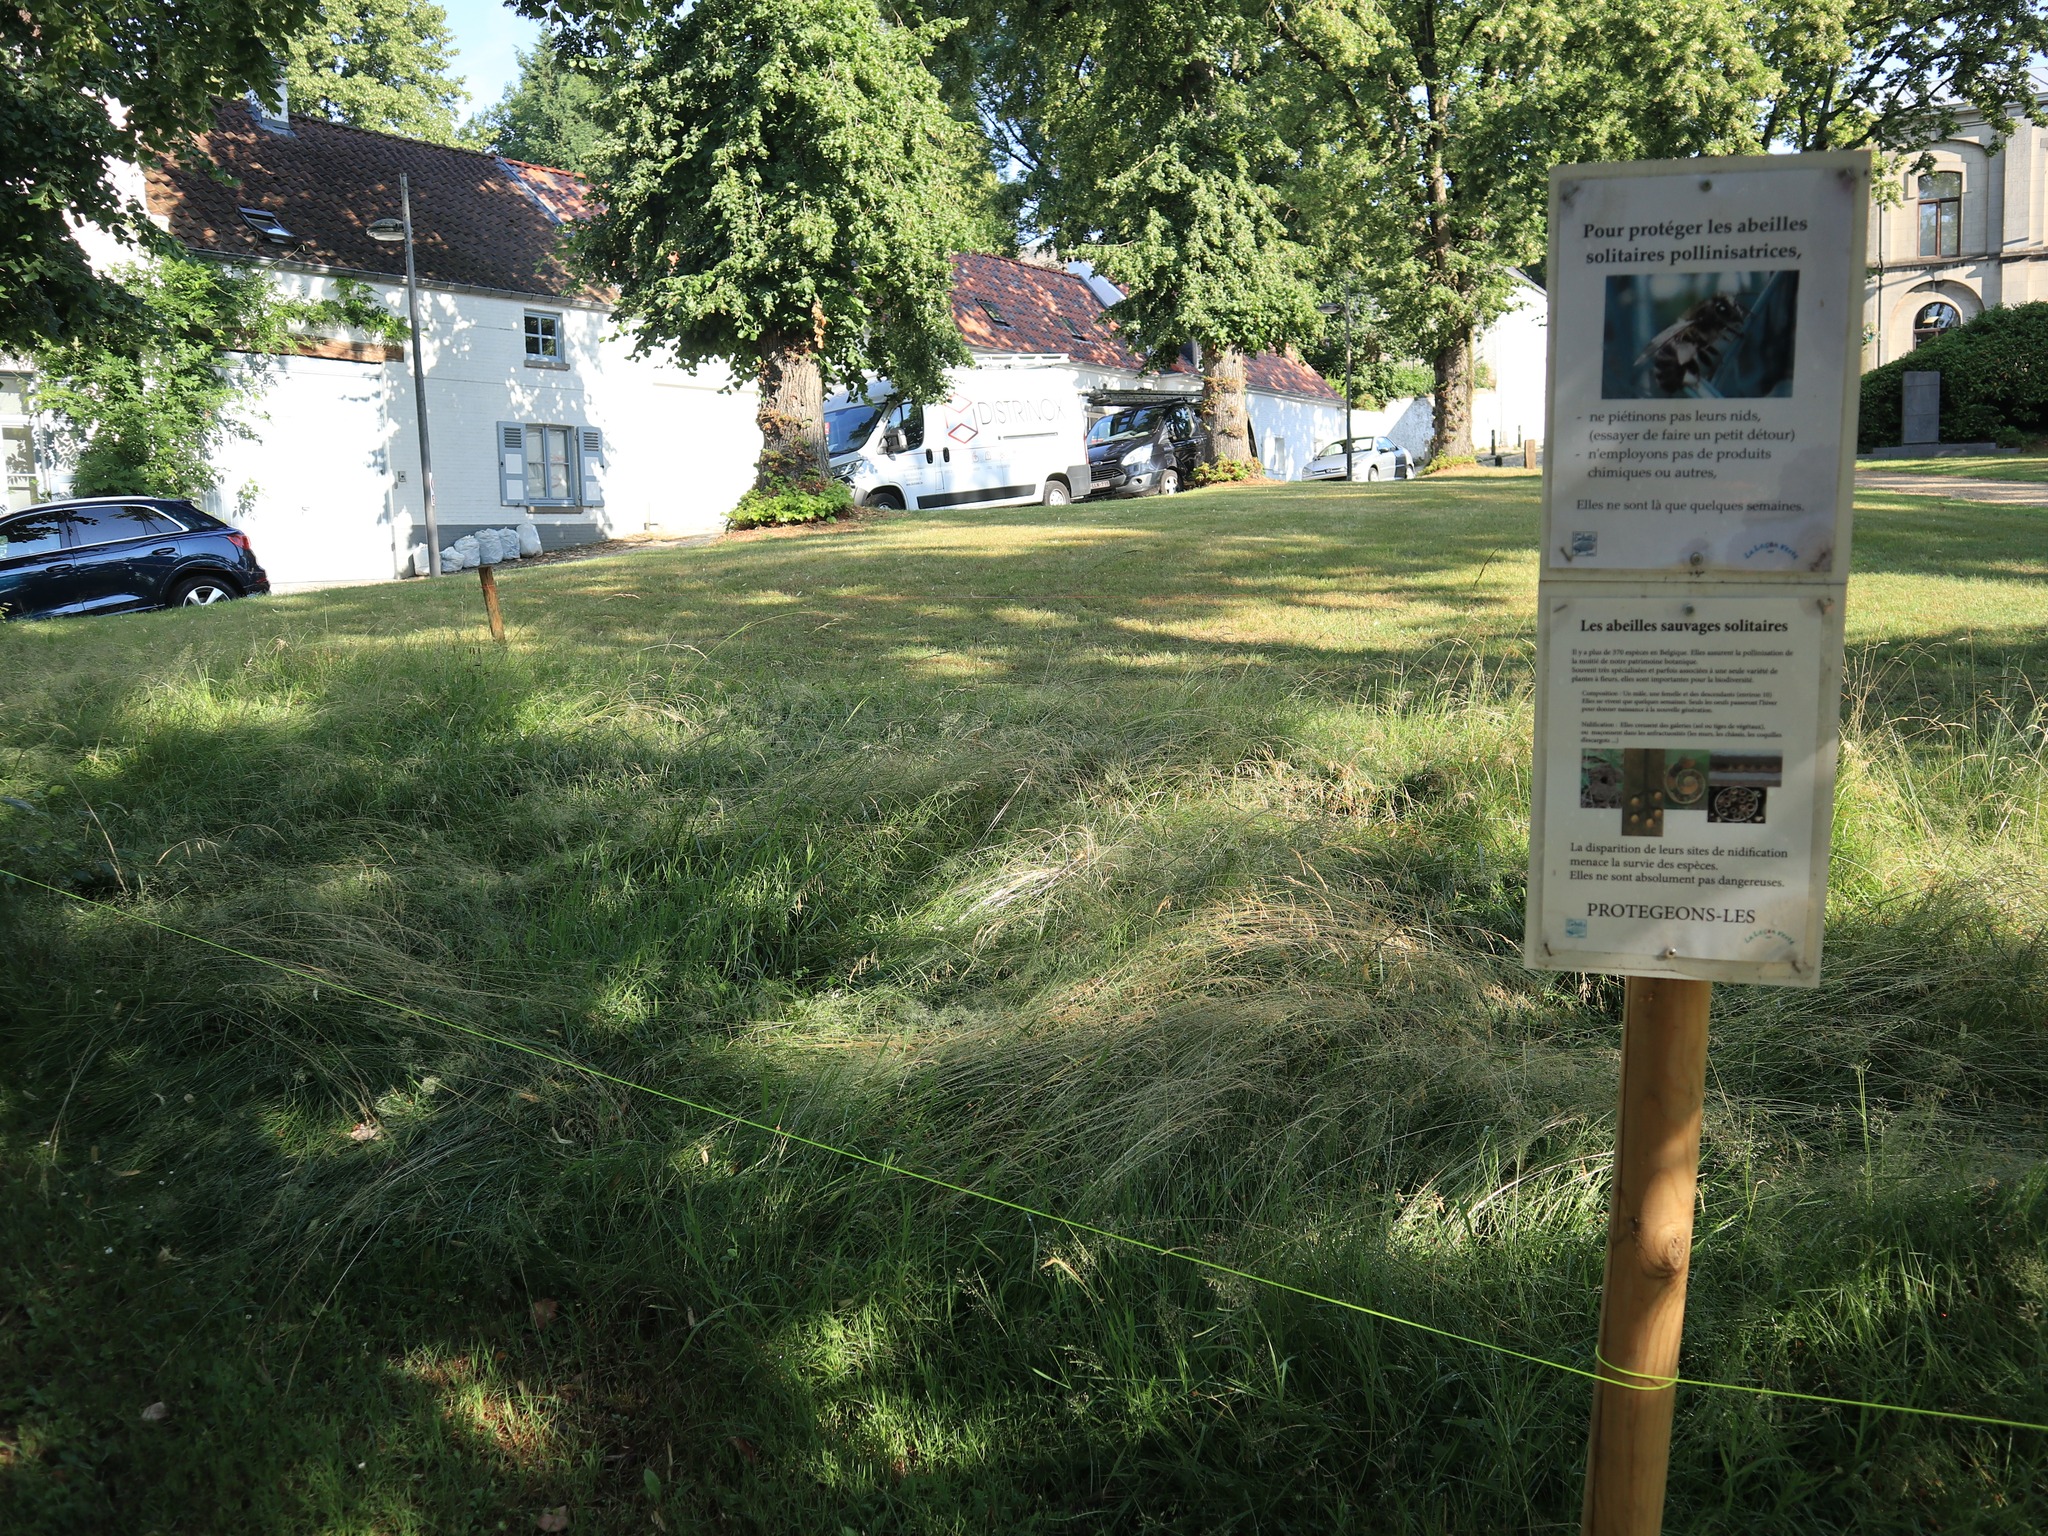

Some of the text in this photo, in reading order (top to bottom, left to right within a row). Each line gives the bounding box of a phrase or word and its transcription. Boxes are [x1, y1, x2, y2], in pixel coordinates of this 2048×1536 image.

[1583, 216, 1809, 242] Pour protéger les abeilles
[1585, 244, 1803, 266] solitaires pollinisatrices,
[978, 398, 1066, 426] DISTRINOX
[1589, 409, 1762, 427] ne piétinons pas leurs nids,
[1588, 428, 1796, 445] (essayer de faire un petit détour)
[1587, 447, 1772, 465] n'employons pas de produits
[1586, 467, 1718, 482] chimiques ou autres,
[1576, 499, 1805, 515] Elles ne sont là que quelques semaines.
[1580, 618, 1789, 636] Les abeilles sauvages solitaires
[1570, 842, 1789, 859] La disparition de leurs sites de nidification
[1569, 857, 1719, 873] menace la survie des espèces.
[1569, 870, 1786, 889] Elles ne sont absolument pas dangereuses.
[1587, 903, 1756, 924] PROTEGEONS-LES
